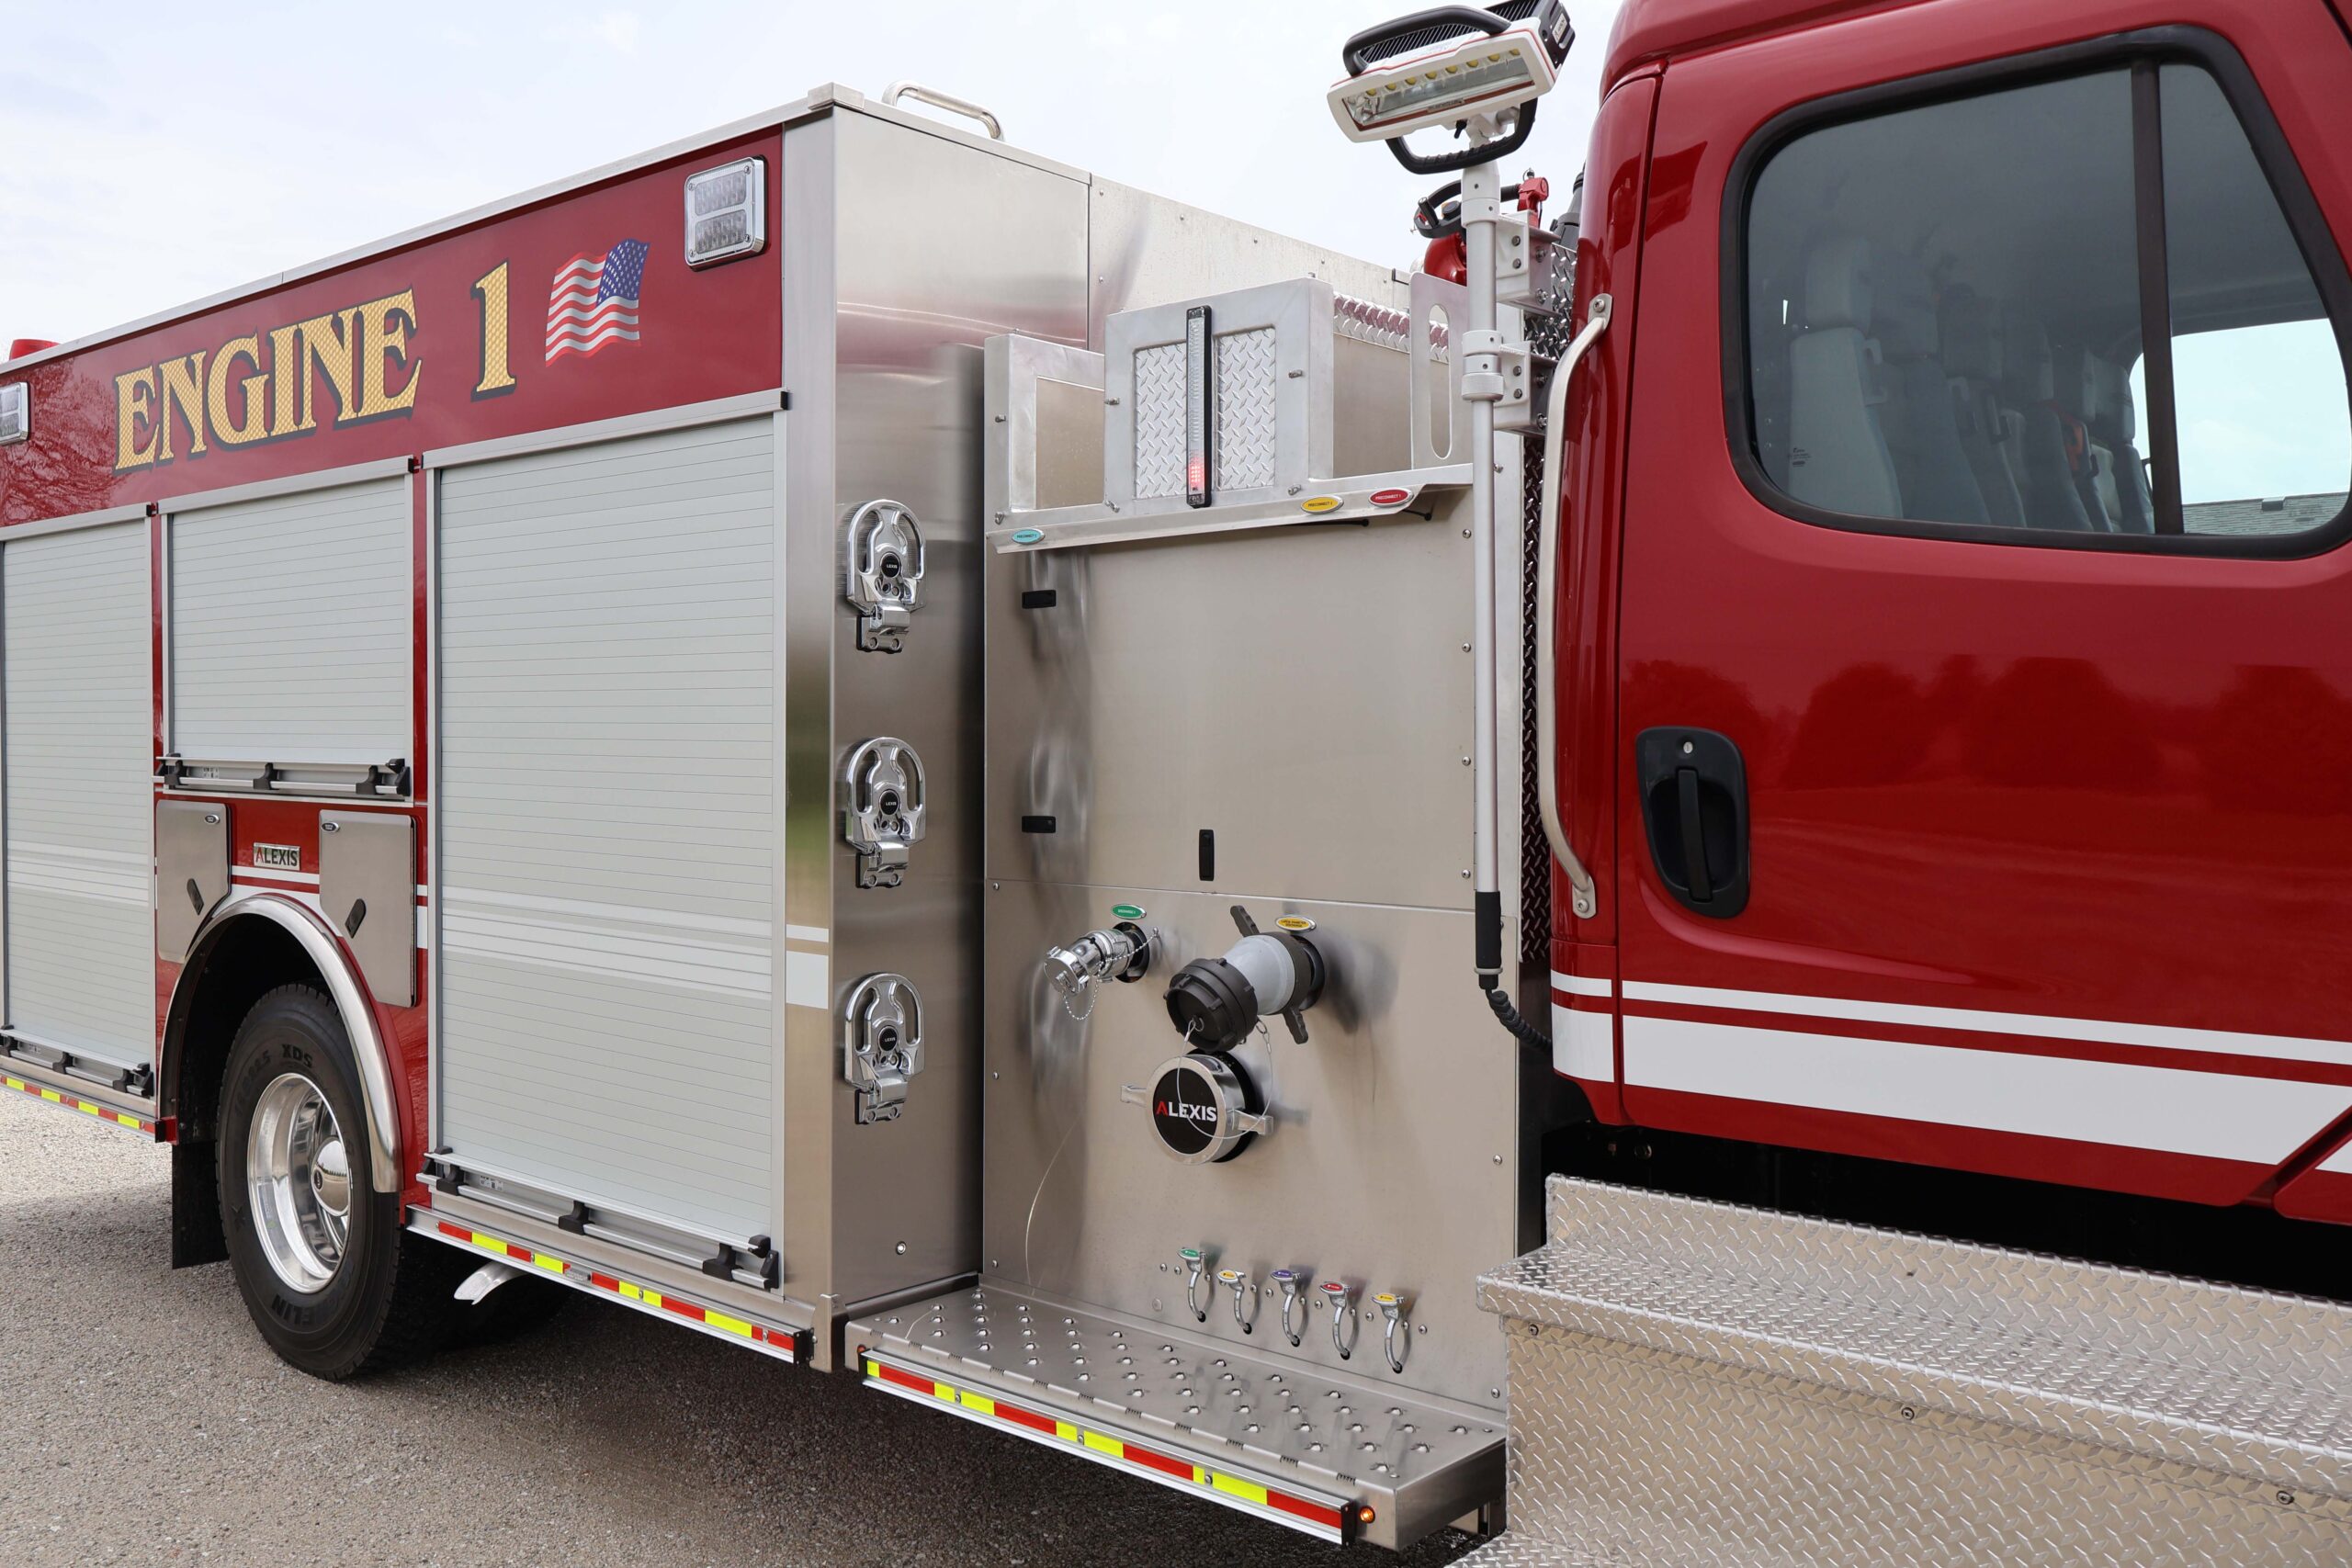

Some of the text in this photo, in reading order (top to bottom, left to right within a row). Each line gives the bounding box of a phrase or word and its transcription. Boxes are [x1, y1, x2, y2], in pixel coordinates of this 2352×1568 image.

[114, 258, 517, 473] ENGINE 1
[255, 847, 298, 866] ALEXIS
[281, 1043, 313, 1068] XDS
[1156, 1100, 1217, 1122] ALEXIS
